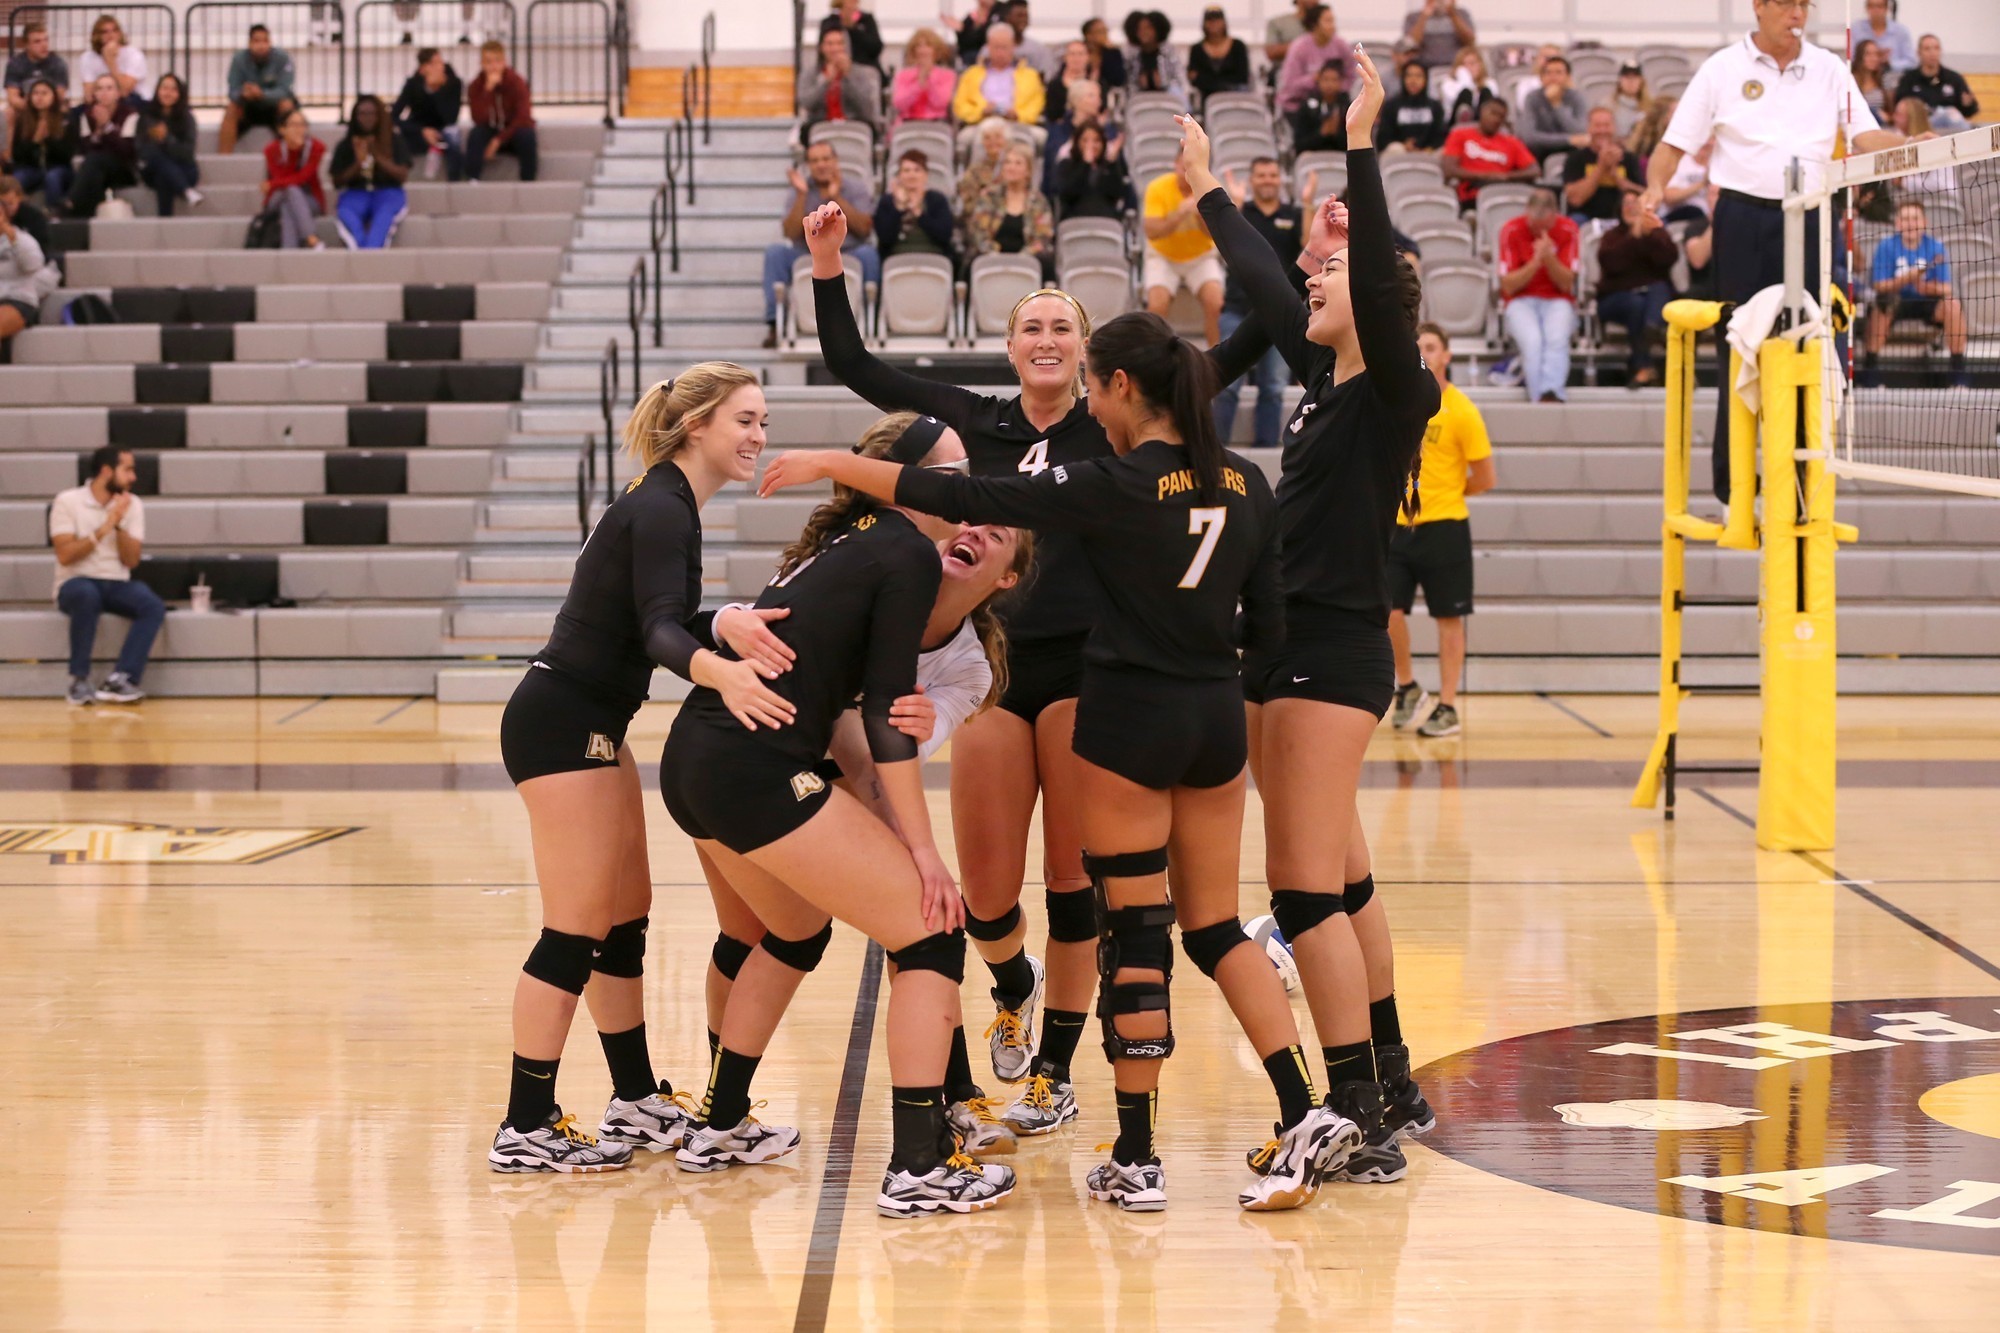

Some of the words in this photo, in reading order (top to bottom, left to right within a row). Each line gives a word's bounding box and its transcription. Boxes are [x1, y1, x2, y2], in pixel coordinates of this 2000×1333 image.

[1018, 439, 1049, 477] 4
[1157, 466, 1247, 501] PANRS
[1177, 505, 1228, 589] 7
